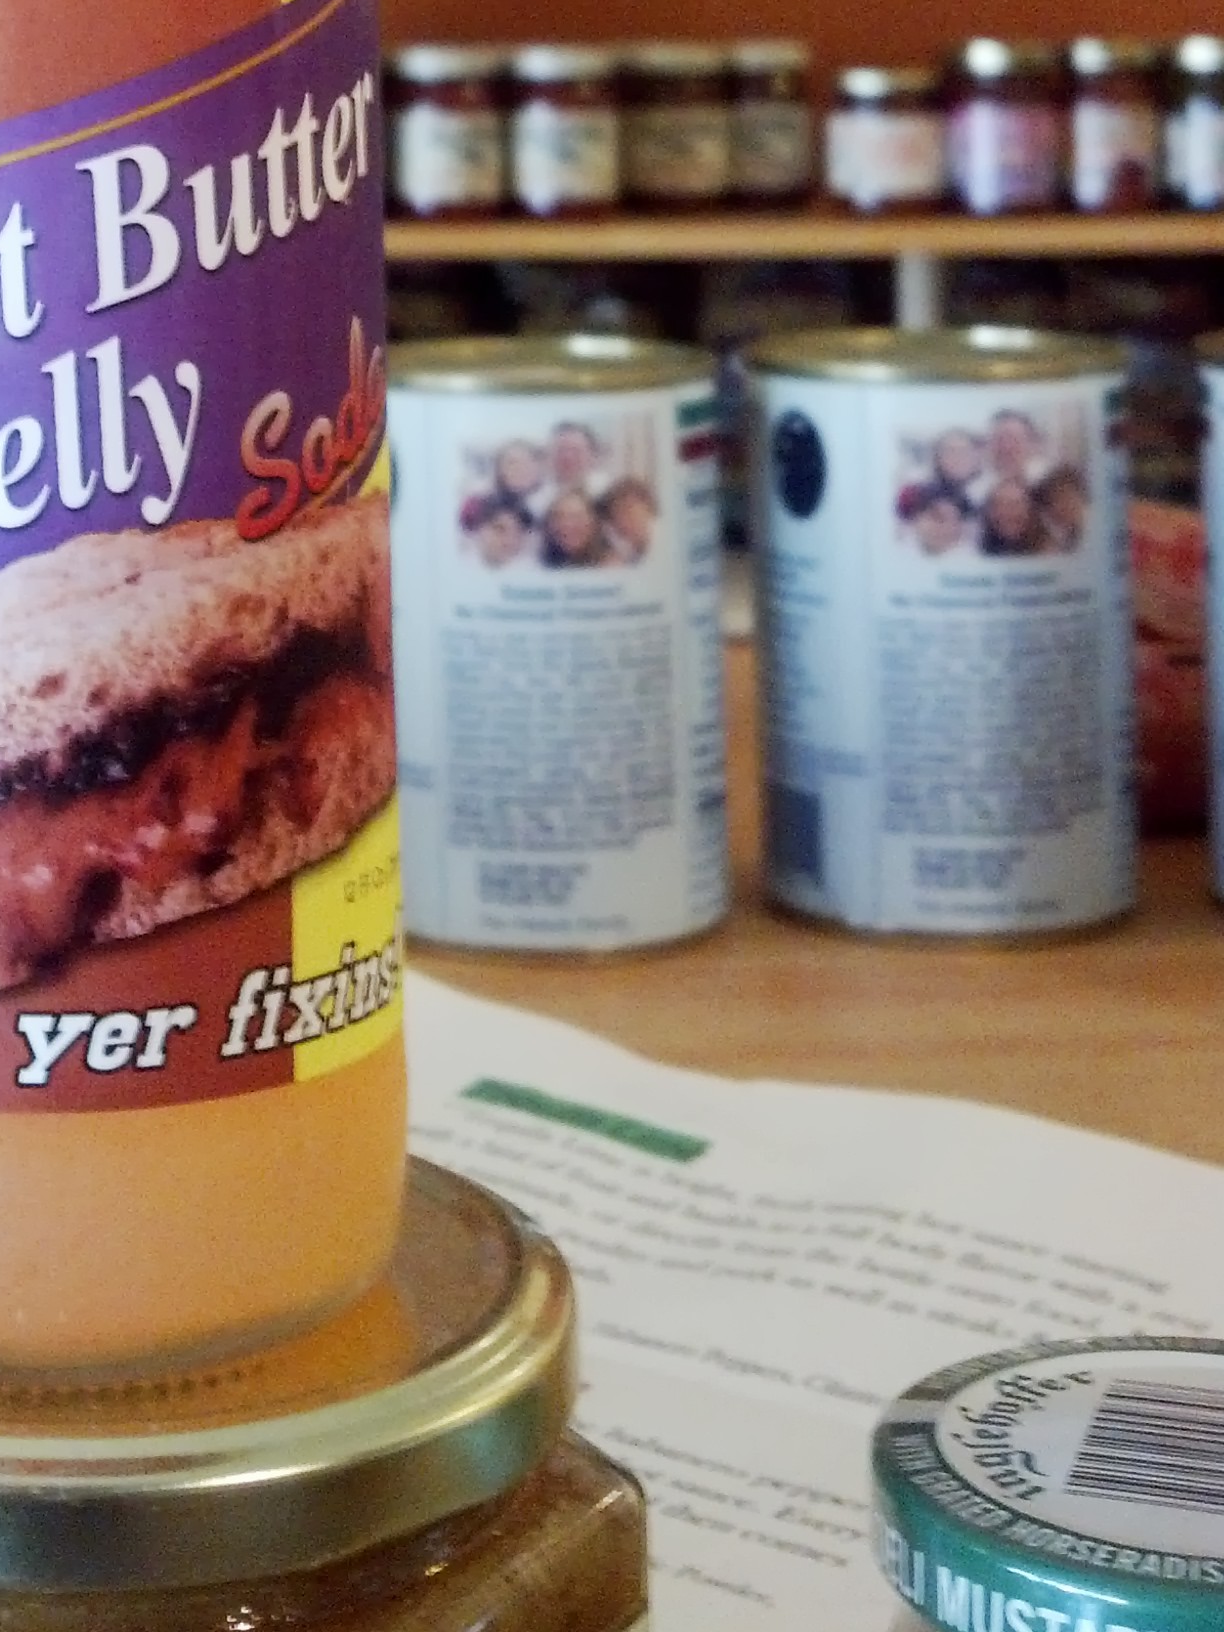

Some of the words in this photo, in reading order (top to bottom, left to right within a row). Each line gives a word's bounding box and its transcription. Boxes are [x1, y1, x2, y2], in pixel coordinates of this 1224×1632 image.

[75, 72, 375, 314] Butter
[15, 1001, 196, 1087] yer
[907, 1468, 1015, 1530] GRATED
[1000, 1518, 1224, 1584] HORSERADIS
[936, 1565, 1160, 1632] MUST
